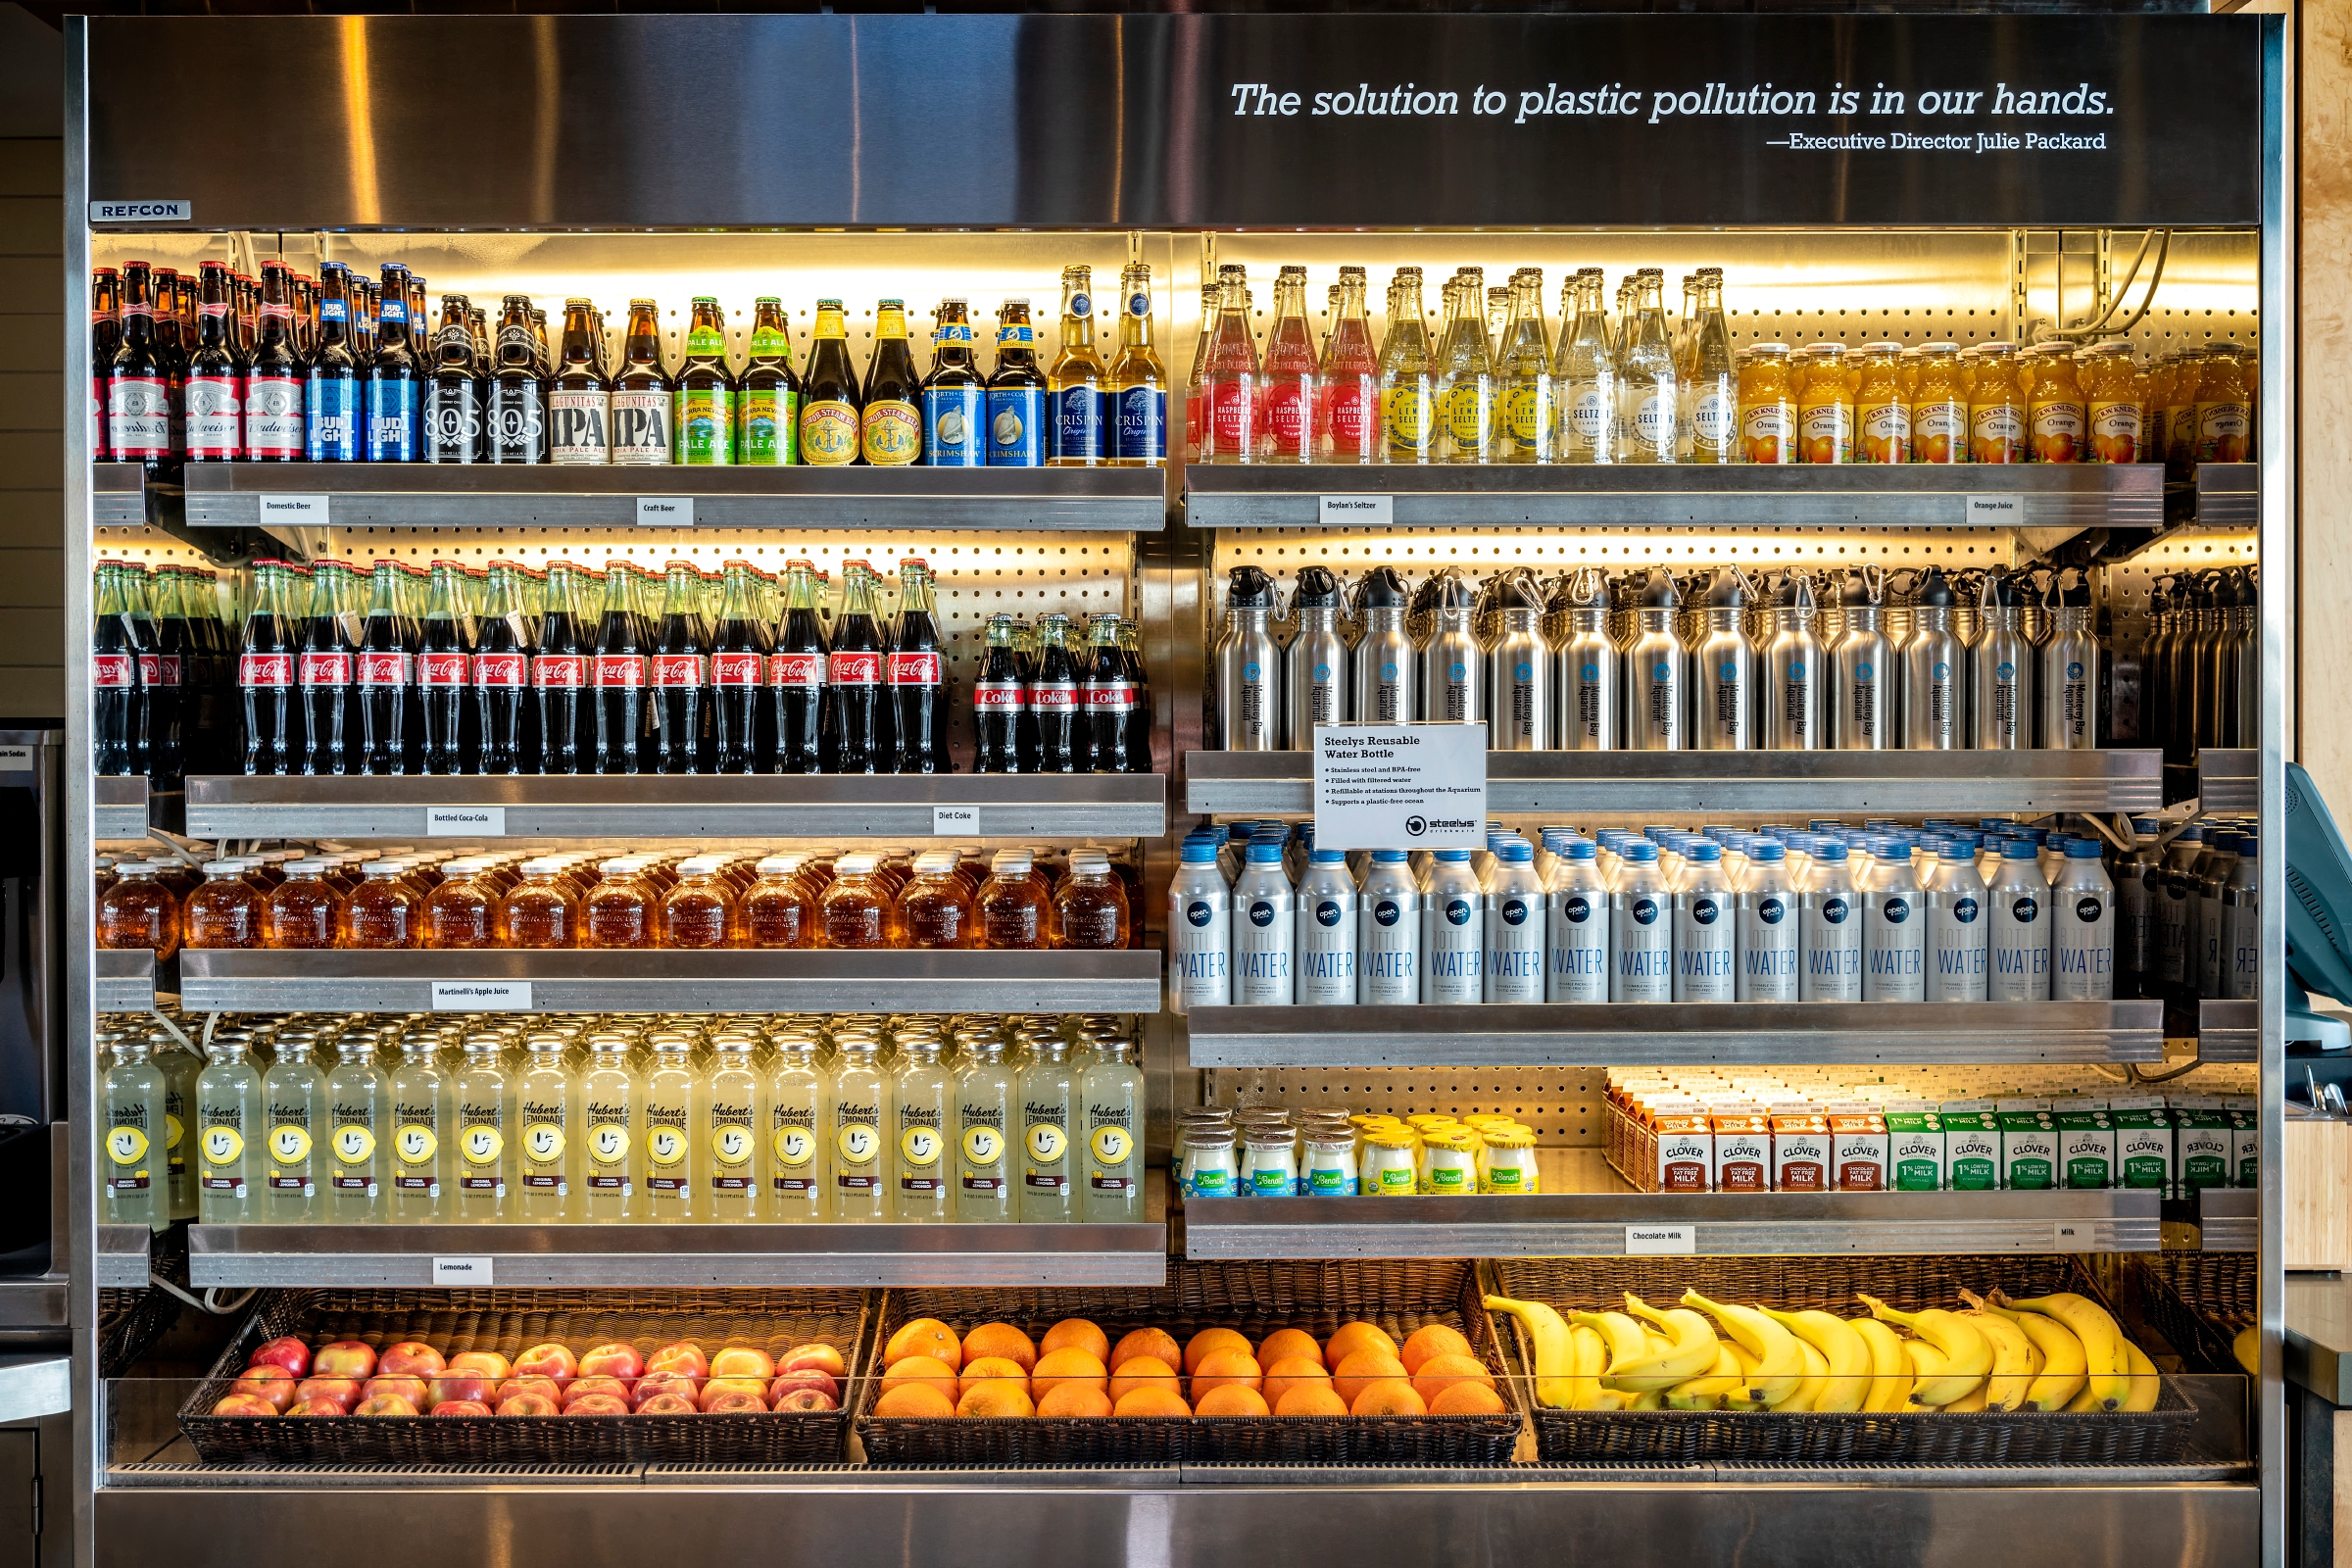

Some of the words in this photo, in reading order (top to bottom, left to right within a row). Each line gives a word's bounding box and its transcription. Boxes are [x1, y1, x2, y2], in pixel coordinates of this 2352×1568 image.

[1231, 84, 1300, 116] The
[1312, 84, 1458, 116] solution
[1471, 88, 1505, 116] to
[1515, 84, 1641, 123] plastic
[1647, 84, 1817, 123] pollution
[1828, 84, 1859, 116] is
[1870, 84, 1905, 116] in
[1918, 92, 1983, 116] our
[1991, 84, 2114, 116] hands.
[1890, 132, 1972, 150] Director
[1976, 132, 2021, 153] Julie
[2026, 132, 2106, 150] Packard
[102, 205, 178, 217] REFCON
[553, 397, 596, 408] LAGUNITAS
[614, 397, 657, 408] LAGUNITAS
[821, 408, 844, 421] STEAM
[2052, 405, 2081, 416] KNUDSEN
[315, 416, 348, 429] BUD
[371, 417, 404, 429] BUD
[425, 408, 481, 437] 805
[487, 409, 543, 438] 805
[1055, 415, 1102, 425] CRISPIN
[1115, 416, 1163, 426] CRISPIN
[1756, 420, 1785, 430] Orange
[1812, 421, 1840, 430] Orange
[1880, 420, 1906, 430] Orange
[1927, 418, 1956, 428] Orange
[1988, 421, 2016, 431] Orange
[2047, 418, 2076, 427] Orange
[2109, 418, 2136, 428] Orange
[552, 409, 606, 447] IPA
[613, 409, 666, 447] IPA
[310, 429, 354, 442] LIGHT
[368, 430, 410, 443] LIGHT
[679, 440, 705, 449] PALE
[709, 440, 729, 449] ALE
[741, 440, 764, 449] PALE
[768, 440, 789, 449] ALE
[242, 660, 287, 677] Coca-Cola
[301, 659, 347, 676] Coca-Cola
[420, 659, 466, 676] Coca-Cola
[535, 661, 581, 678] Coca-Cola
[712, 660, 760, 676] Coca-Cola
[832, 658, 878, 675] Coca-Cola
[890, 659, 936, 676] Coca-Cola
[983, 690, 1015, 704] Coke
[1091, 690, 1123, 704] Coke
[1241, 684, 1252, 721] Aquarium
[1250, 684, 1262, 720] Monterey
[1512, 684, 1524, 721] Aquarium
[1522, 684, 1534, 720] Monterey
[2063, 684, 2076, 720] Aquarium
[2074, 684, 2085, 720] Monterey
[1250, 721, 1262, 736] Bay
[1522, 721, 1534, 736] Bay
[2073, 720, 2085, 736] Bay
[1325, 737, 1364, 748] Steelys
[1367, 736, 1420, 746] Reusable
[1325, 750, 1357, 759] Water
[1361, 749, 1394, 759] Bottle
[1430, 818, 1475, 828] steelys
[1190, 907, 1209, 919] open
[1319, 907, 1339, 919] open
[1568, 906, 1588, 915] open
[1826, 906, 1845, 916] open
[2080, 905, 2098, 915] open
[1237, 952, 1288, 977] WATER
[1302, 952, 1352, 977] WATER
[1489, 951, 1540, 977] WATER
[1551, 948, 1602, 974] WATER
[1808, 949, 1859, 975] WATER
[1937, 948, 1986, 974] WATER
[2060, 948, 2111, 973] WATER
[201, 1103, 242, 1116] Hubert's
[523, 1102, 565, 1114] Hubert's
[711, 1102, 755, 1116] Hubert's
[838, 1102, 880, 1114] Hubert's
[201, 1116, 241, 1129] LEMONADE
[523, 1114, 564, 1127] LEMONADE
[711, 1116, 753, 1129] LEMONADE
[838, 1114, 879, 1128] LEMONADE
[1666, 1147, 1704, 1158] CLOVER
[1783, 1146, 1821, 1158] CLOVER
[1899, 1145, 1936, 1157] CLOVER
[1955, 1144, 1992, 1156] CLOVER
[2126, 1143, 2164, 1154] CLOVER
[1958, 1164, 1969, 1175] 1%
